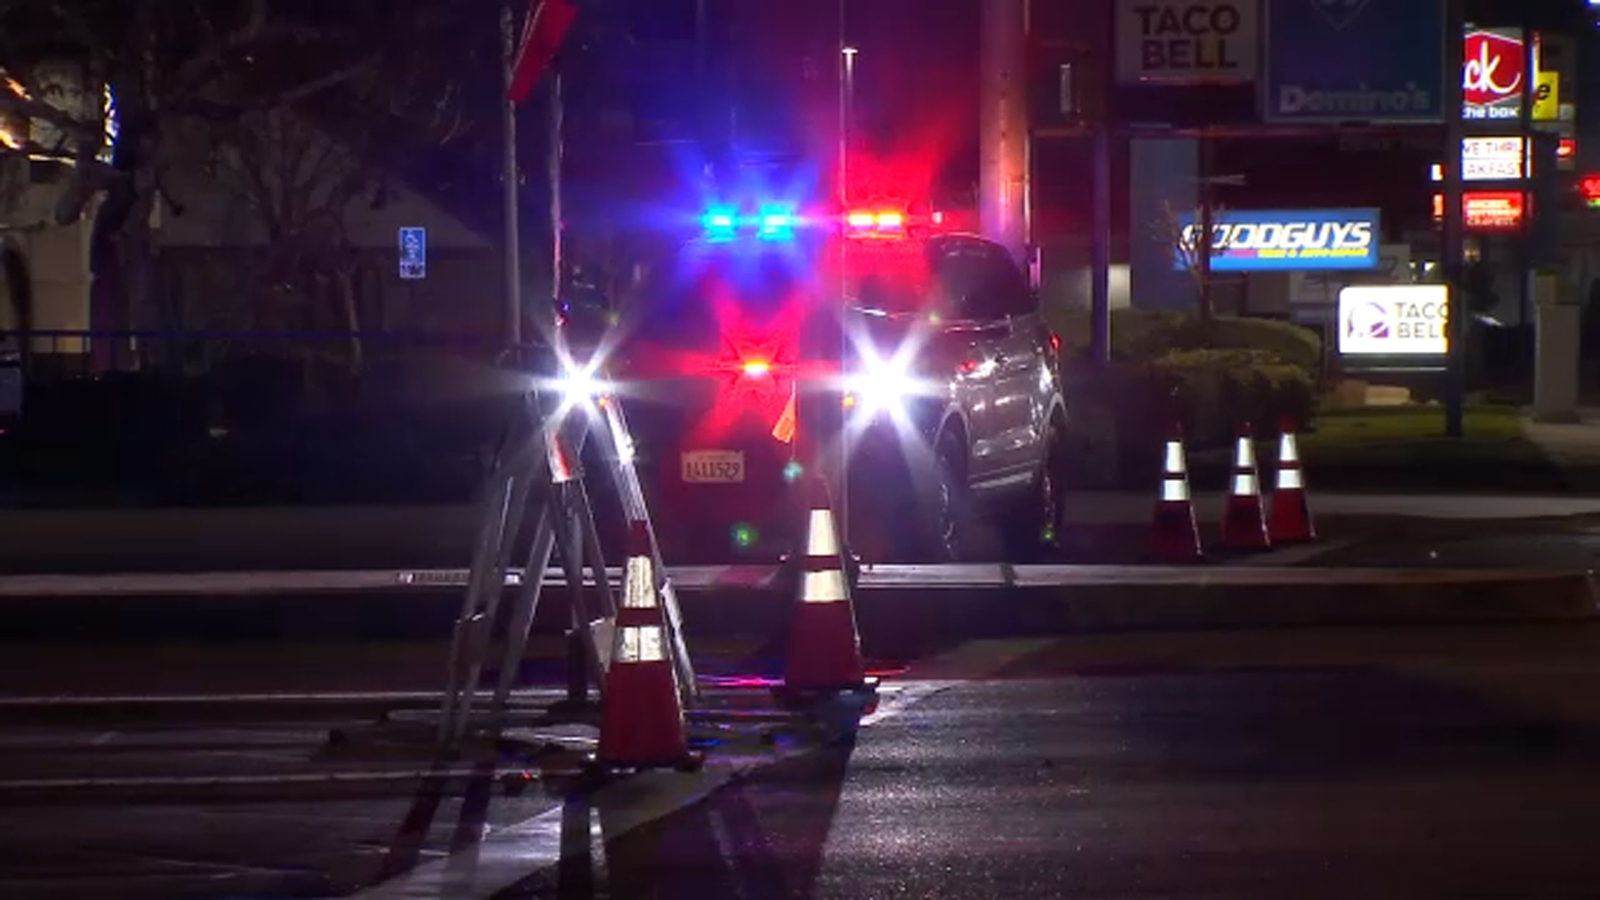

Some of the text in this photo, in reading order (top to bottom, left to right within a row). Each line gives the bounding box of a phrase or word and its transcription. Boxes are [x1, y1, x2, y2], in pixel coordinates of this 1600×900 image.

[1134, 5, 1240, 35] TACO
[1142, 40, 1238, 70] BELL
[1279, 81, 1431, 113] Domino's
[1489, 107, 1519, 119] box
